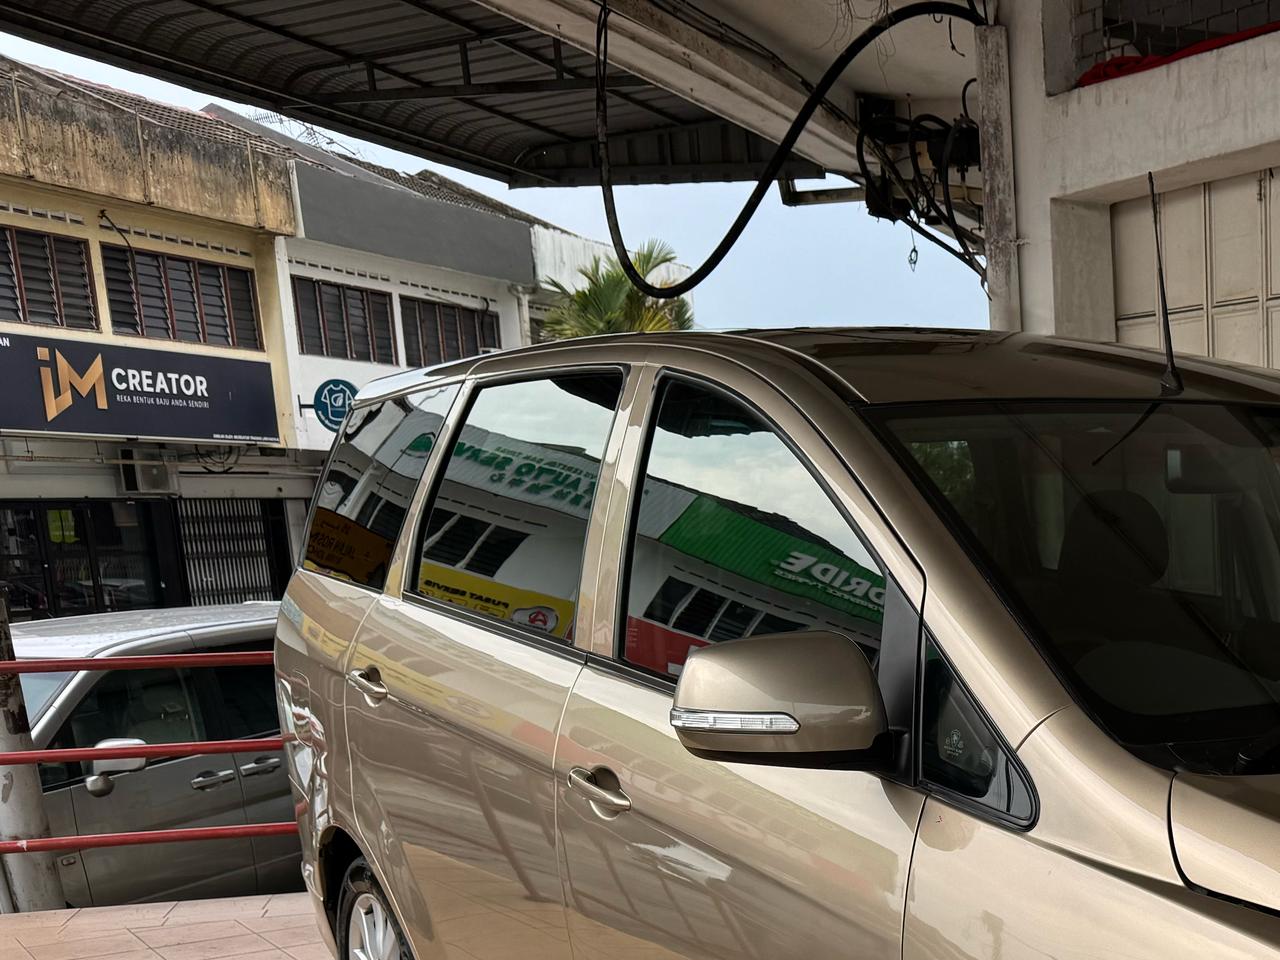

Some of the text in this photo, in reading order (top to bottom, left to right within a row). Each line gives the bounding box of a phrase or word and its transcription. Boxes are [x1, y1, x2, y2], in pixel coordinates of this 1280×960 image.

[111, 367, 208, 397] CREATOR
[116, 394, 210, 409] REKA BENTUK BAJU ANDA SENDIRI
